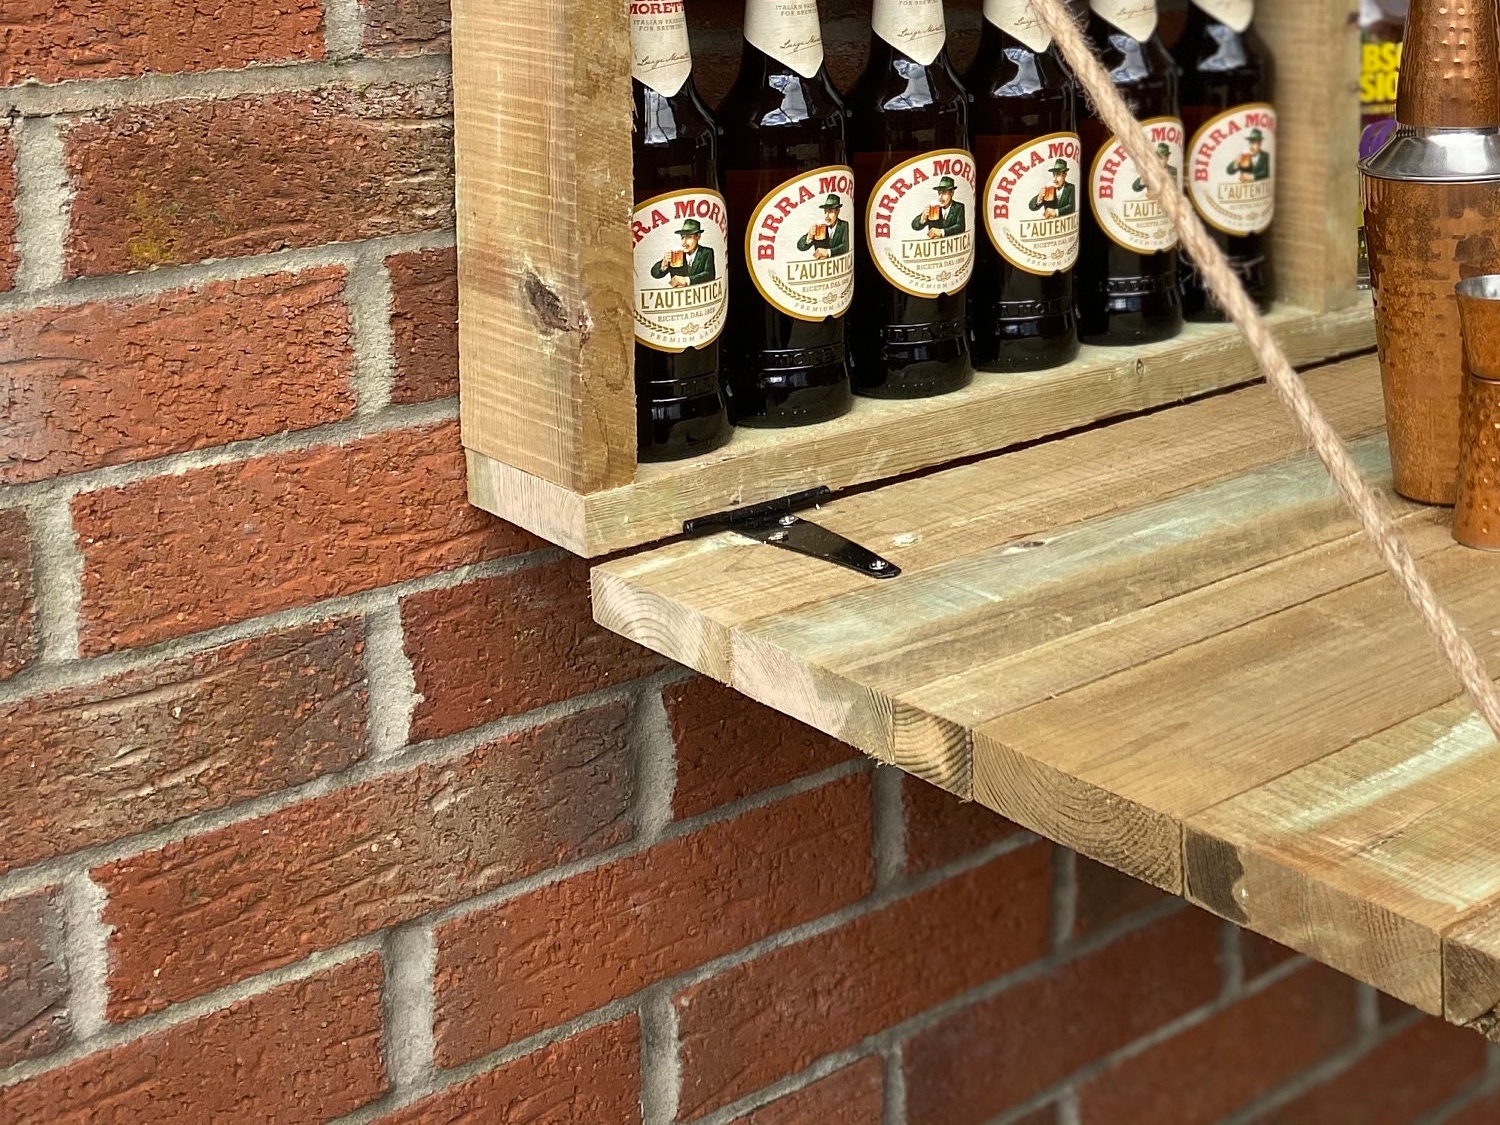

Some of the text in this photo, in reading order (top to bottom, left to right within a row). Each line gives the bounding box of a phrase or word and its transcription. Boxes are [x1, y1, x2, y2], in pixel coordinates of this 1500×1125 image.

[1194, 120, 1242, 182] BIRRA
[757, 175, 854, 261] BIRRA MOR
[875, 167, 930, 239] BIRRA
[994, 151, 1045, 220] BIRRA
[901, 234, 972, 259] L'AUTENTICA
[641, 281, 723, 310] L'AUTENTICA
